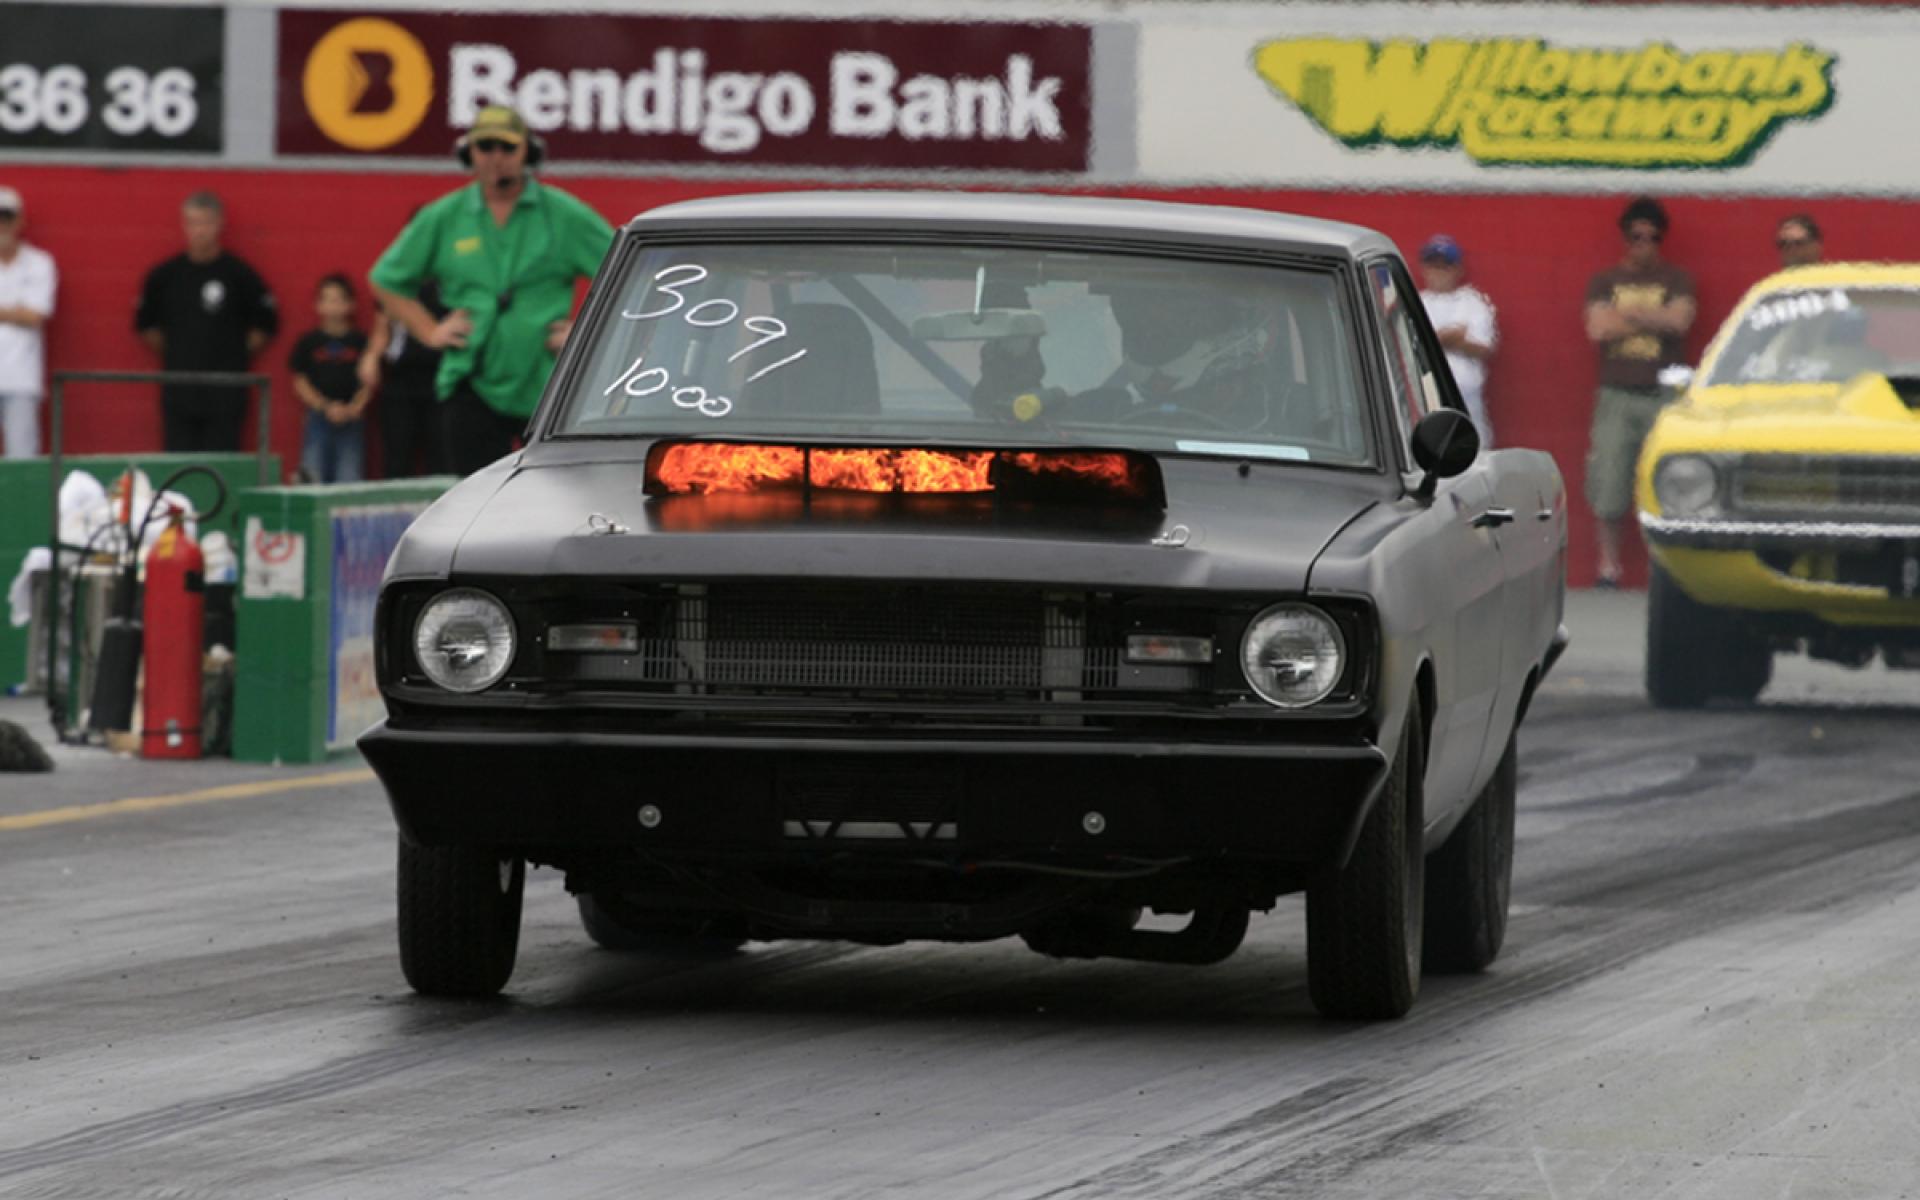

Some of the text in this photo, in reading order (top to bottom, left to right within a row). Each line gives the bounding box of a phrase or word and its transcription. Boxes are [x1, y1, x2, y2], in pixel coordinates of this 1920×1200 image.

[0, 63, 199, 137] 36 36
[448, 43, 1064, 152] Bendigo Bank
